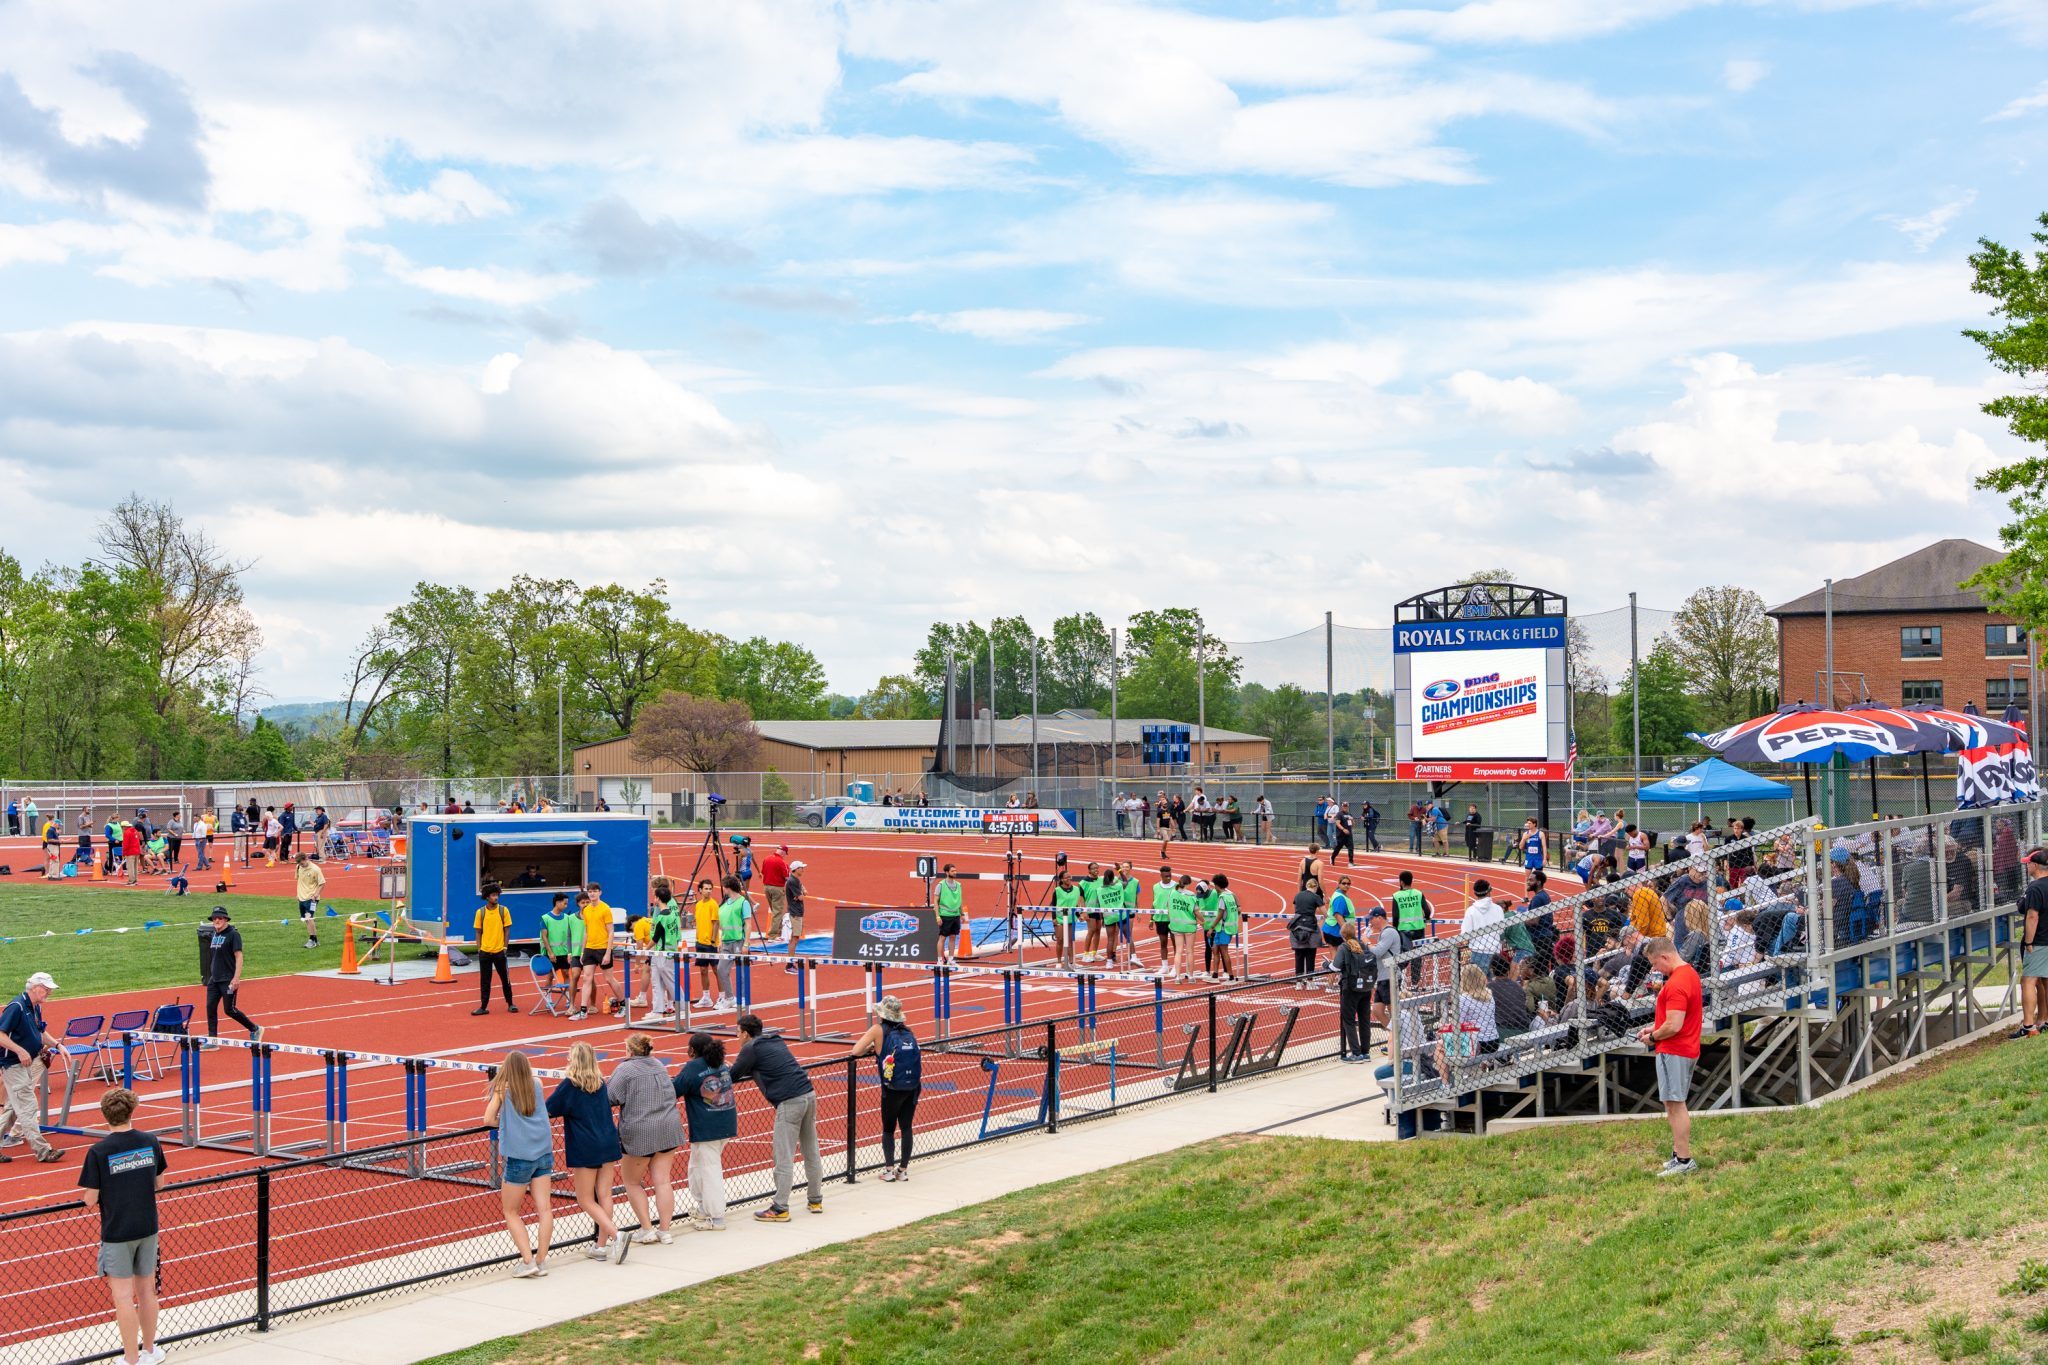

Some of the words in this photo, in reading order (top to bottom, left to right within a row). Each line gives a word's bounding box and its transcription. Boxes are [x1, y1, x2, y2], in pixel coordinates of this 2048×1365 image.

[1464, 604, 1491, 618] EMU
[1400, 629, 1466, 647] ROYALS
[1468, 629, 1510, 642] TRACK
[1512, 628, 1520, 640] &
[1522, 627, 1559, 639] FIELD
[1422, 682, 1537, 723] CHAMPIONSHIPS
[1767, 727, 1891, 751] PEPSI
[1414, 764, 1452, 778] PARTNERS
[1473, 767, 1517, 777] Empowering
[1519, 767, 1547, 775] Growth
[898, 808, 962, 817] WELCOME
[964, 809, 979, 818] TO
[884, 818, 919, 828] ODAC
[921, 818, 984, 828] CHAMPIO
[988, 821, 1034, 833] 4:57:16
[1101, 890, 1121, 900] EVENT
[862, 918, 917, 931] ODAC
[859, 944, 920, 956] 4:57:16
[112, 1156, 153, 1173] patagonia
